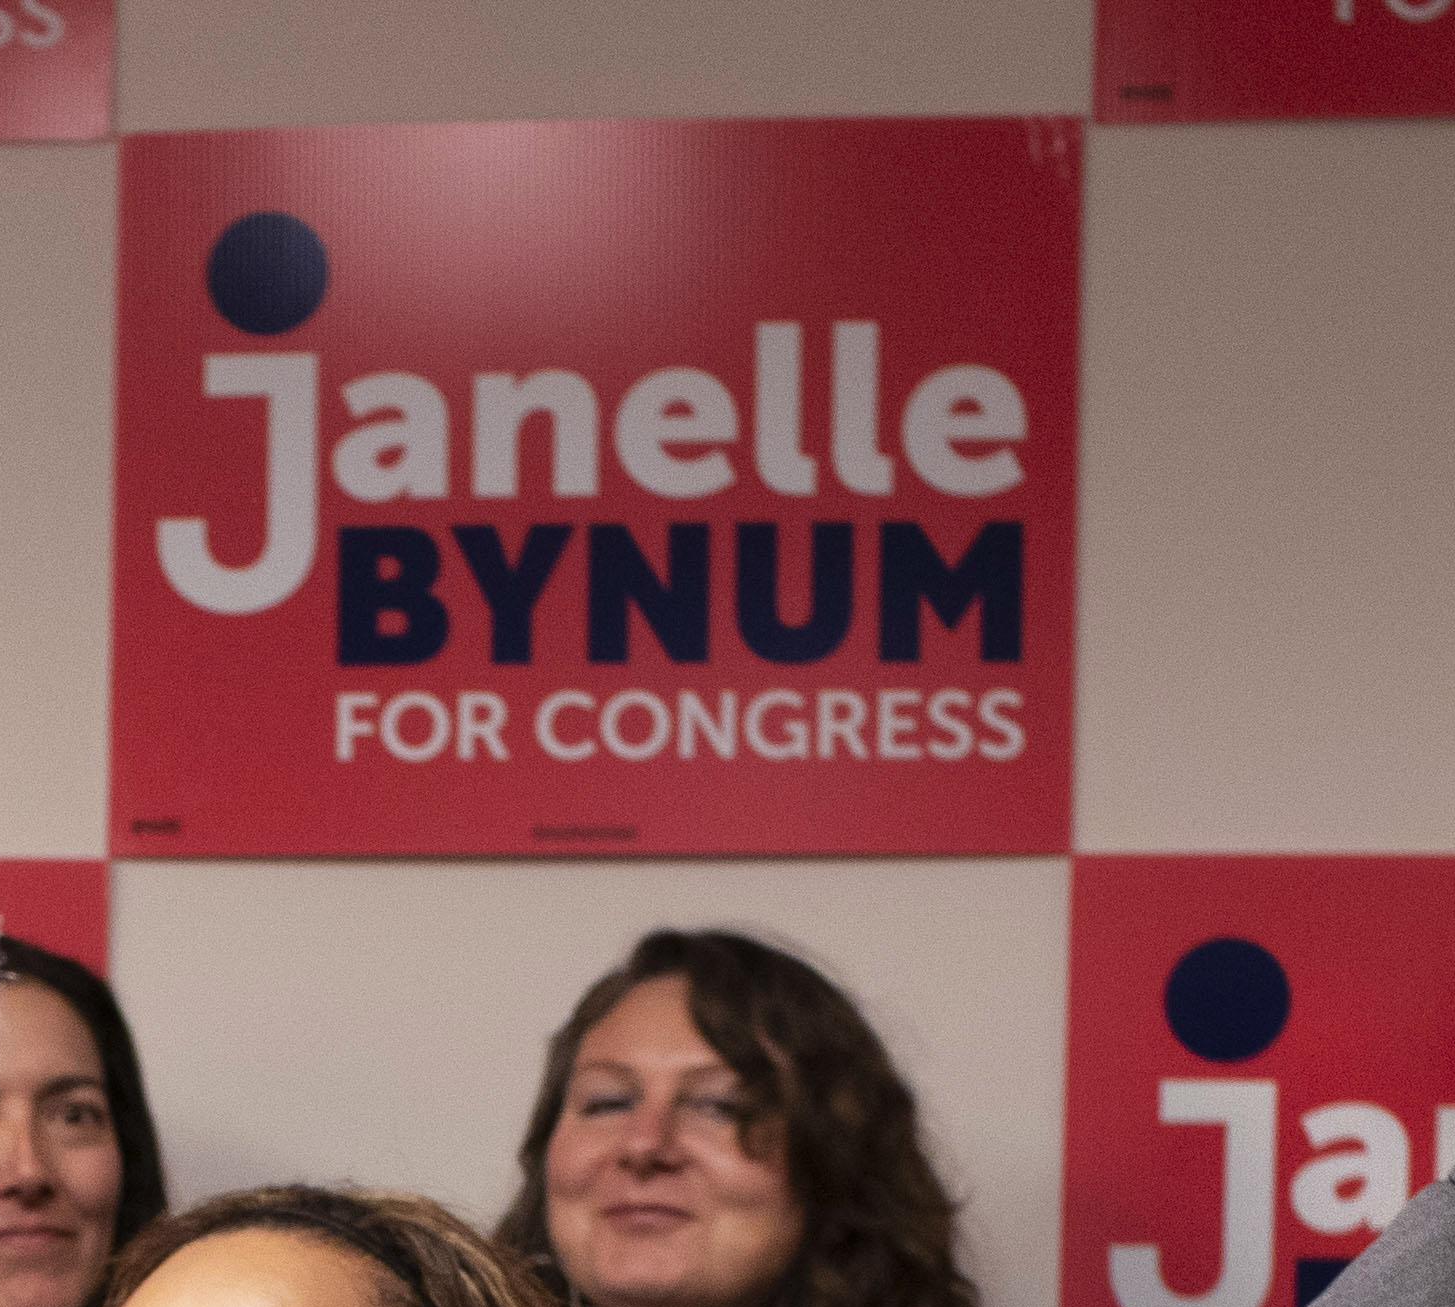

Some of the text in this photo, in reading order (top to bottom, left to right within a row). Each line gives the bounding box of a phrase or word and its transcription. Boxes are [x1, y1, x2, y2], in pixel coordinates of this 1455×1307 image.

[336, 521, 1025, 667] BYNUM
[335, 688, 1027, 762] FOR CONGRESS
